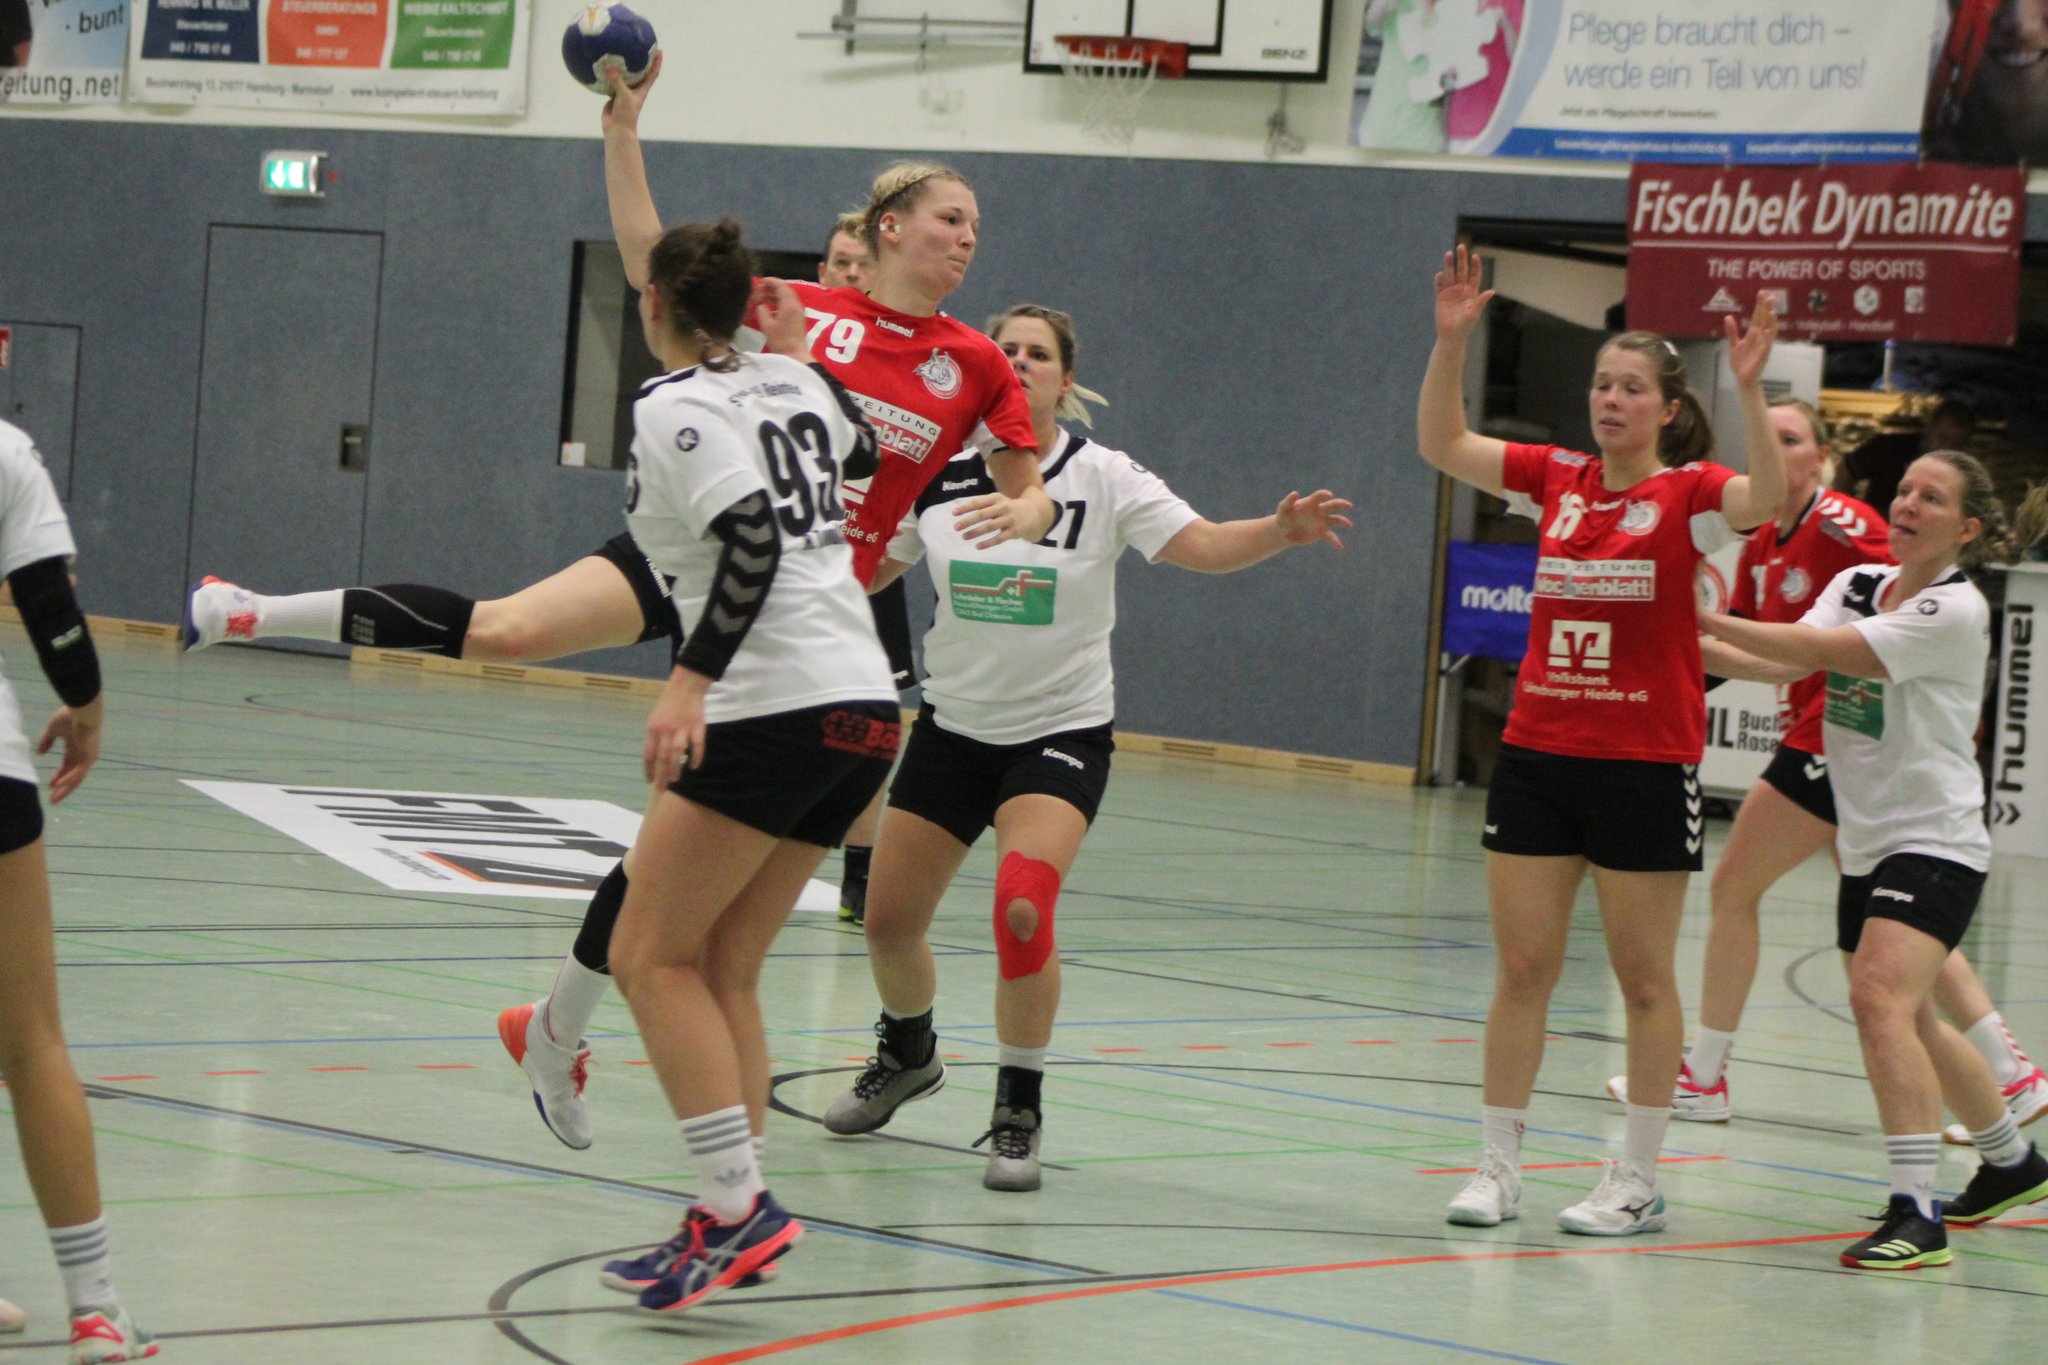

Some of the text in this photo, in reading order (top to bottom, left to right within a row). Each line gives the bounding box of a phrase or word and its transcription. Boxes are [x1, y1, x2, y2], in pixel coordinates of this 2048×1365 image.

[79, 4, 124, 34] bunt
[1655, 14, 1757, 46] braucht
[1767, 14, 1825, 45] dich
[0, 74, 120, 101] eitung.net
[1564, 58, 1866, 90] werde ein Teil von uns!
[1633, 178, 2014, 250] Fischbek Dynamite
[1707, 258, 1926, 280] THE POWER OF SPORTS
[803, 306, 866, 364] 79
[876, 316, 914, 338] hummel
[758, 411, 847, 537] 93
[839, 523, 864, 540] eide
[1996, 604, 2035, 793] hummel
[1042, 747, 1085, 770] Kempa
